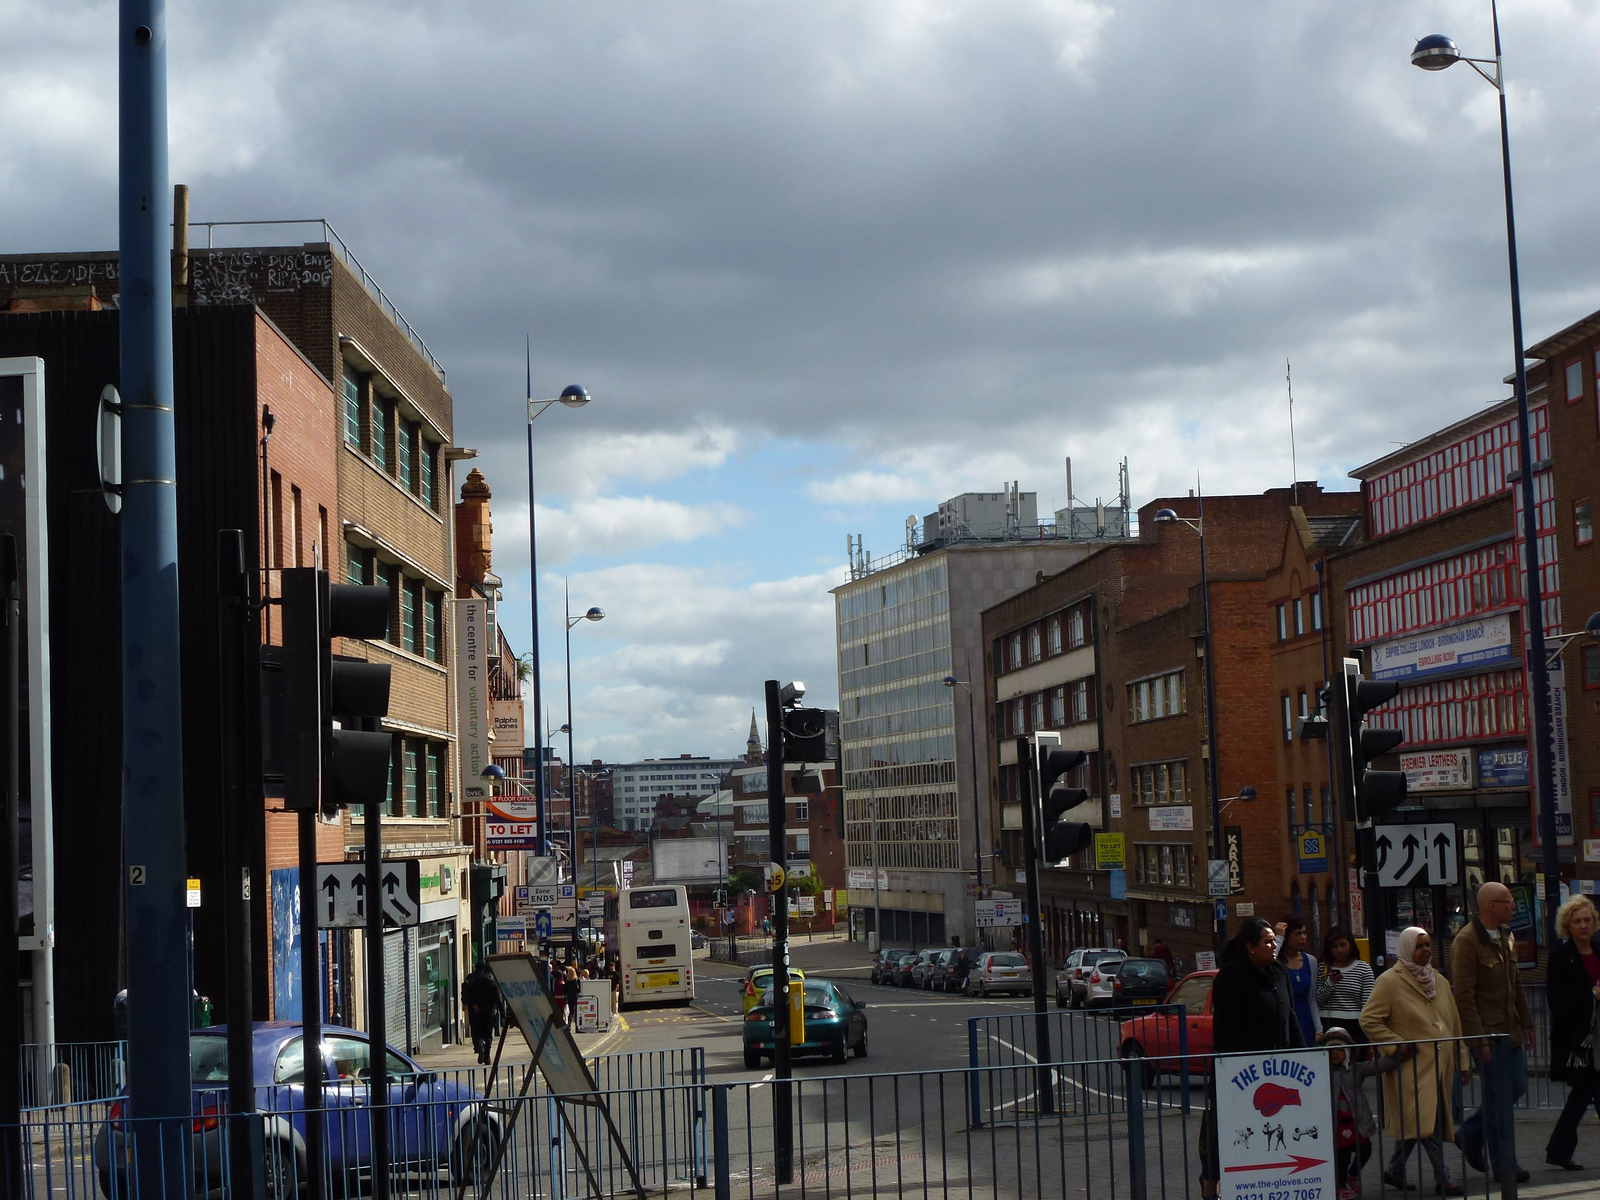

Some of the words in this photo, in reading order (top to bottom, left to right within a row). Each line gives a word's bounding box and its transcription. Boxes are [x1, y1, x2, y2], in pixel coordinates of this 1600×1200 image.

[466, 604, 477, 622] the
[467, 625, 477, 661] centre
[1400, 641, 1418, 655] COLLEGE
[1418, 638, 1435, 651] LONDON
[1438, 631, 1466, 647] BIRMINGHAM
[1466, 627, 1485, 641] BRANCH
[1418, 653, 1443, 667] ENROLLING
[1443, 651, 1456, 662] NOW!
[467, 665, 478, 681] for
[468, 685, 481, 739] voluntary
[470, 742, 482, 777] action
[1401, 755, 1427, 770] PREMIER
[1429, 753, 1458, 768] LEATHERS
[465, 789, 483, 798] bvsc
[488, 824, 506, 835] TO
[510, 824, 533, 835] LET
[1227, 834, 1240, 888] KARATE
[131, 867, 143, 884] 2
[1231, 1063, 1260, 1091] THE
[1262, 1058, 1316, 1087] GLOVES
[1235, 1176, 1322, 1191] www.the-gloves.com
[1236, 1192, 1265, 1200] 0121
[1269, 1190, 1290, 1200] 622
[1294, 1188, 1322, 1200] 7067
